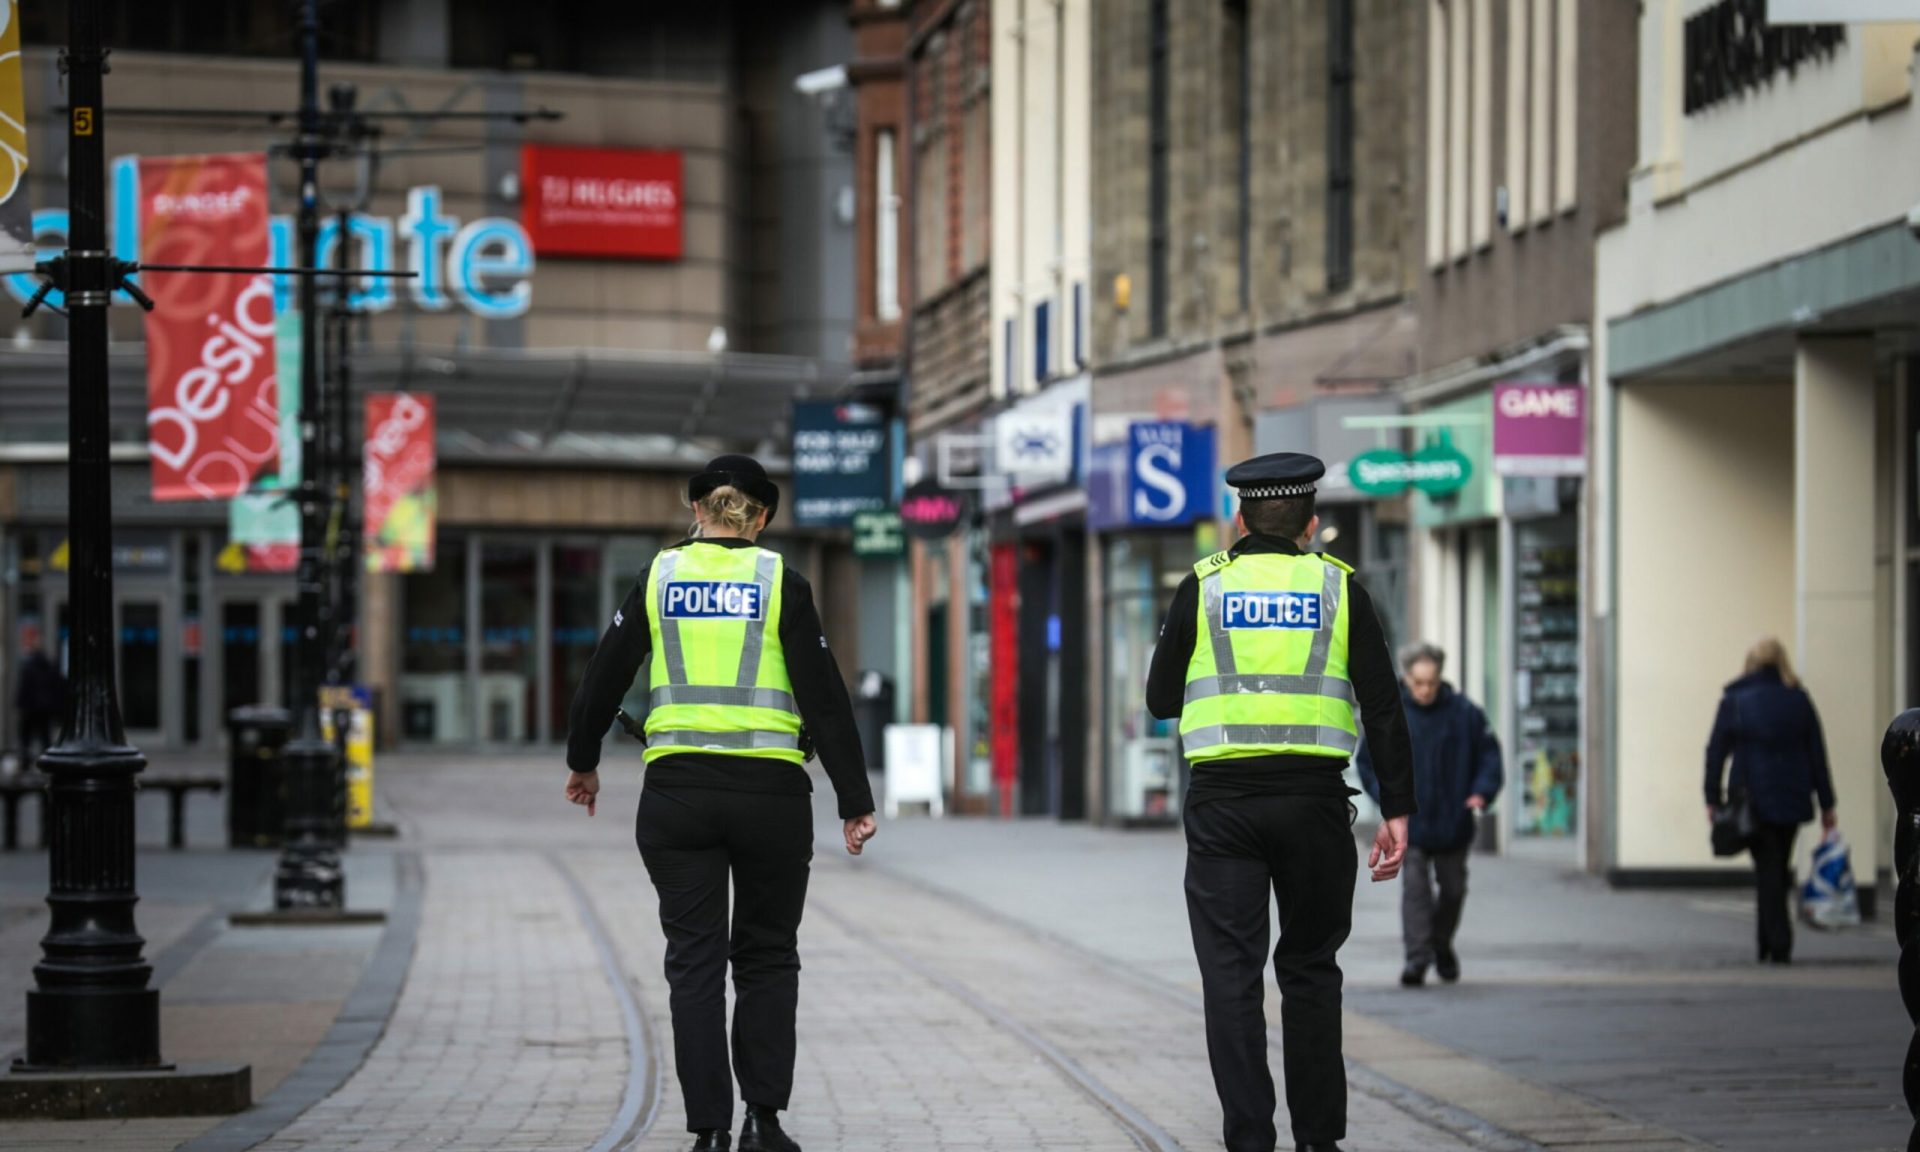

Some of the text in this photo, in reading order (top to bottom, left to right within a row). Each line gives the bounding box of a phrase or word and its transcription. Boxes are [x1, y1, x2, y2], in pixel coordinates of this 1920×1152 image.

[76, 109, 89, 132] 5
[1500, 388, 1578, 418] GAME
[1134, 443, 1186, 522] S
[667, 586, 757, 615] POLICE
[1226, 596, 1318, 624] POLICE
